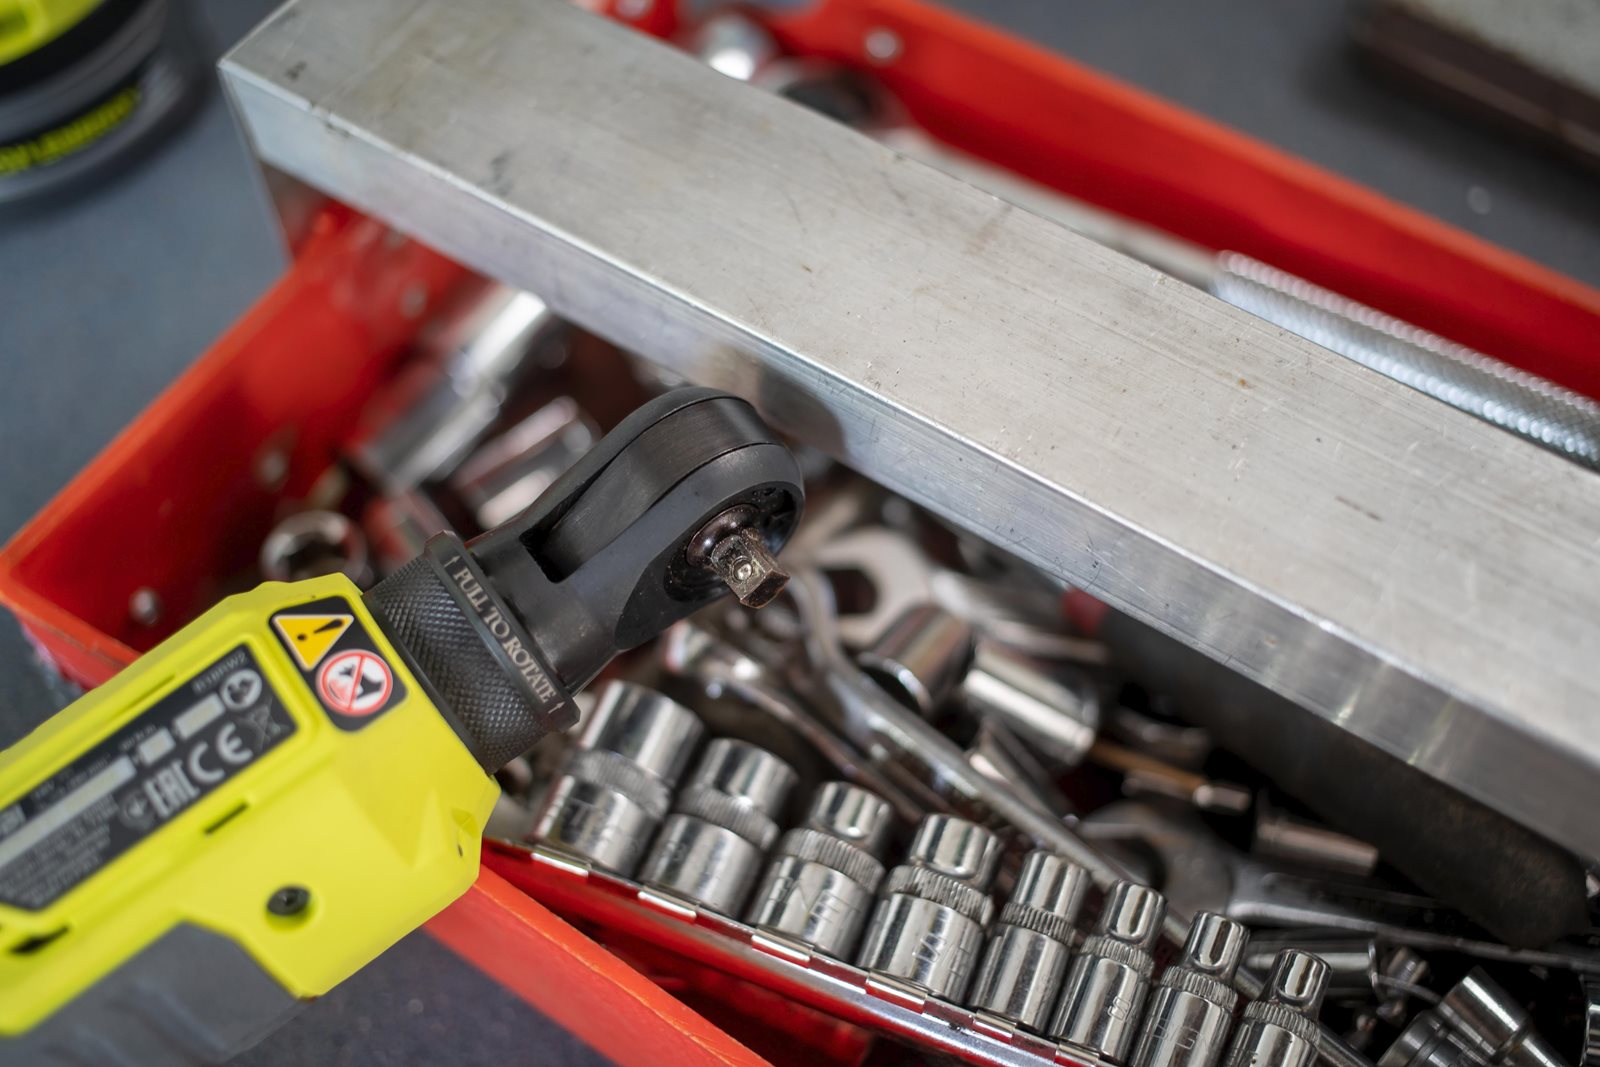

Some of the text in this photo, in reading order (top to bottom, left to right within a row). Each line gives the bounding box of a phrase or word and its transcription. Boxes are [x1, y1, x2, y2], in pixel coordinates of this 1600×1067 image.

[453, 567, 557, 704] PULL TO ROTATE
